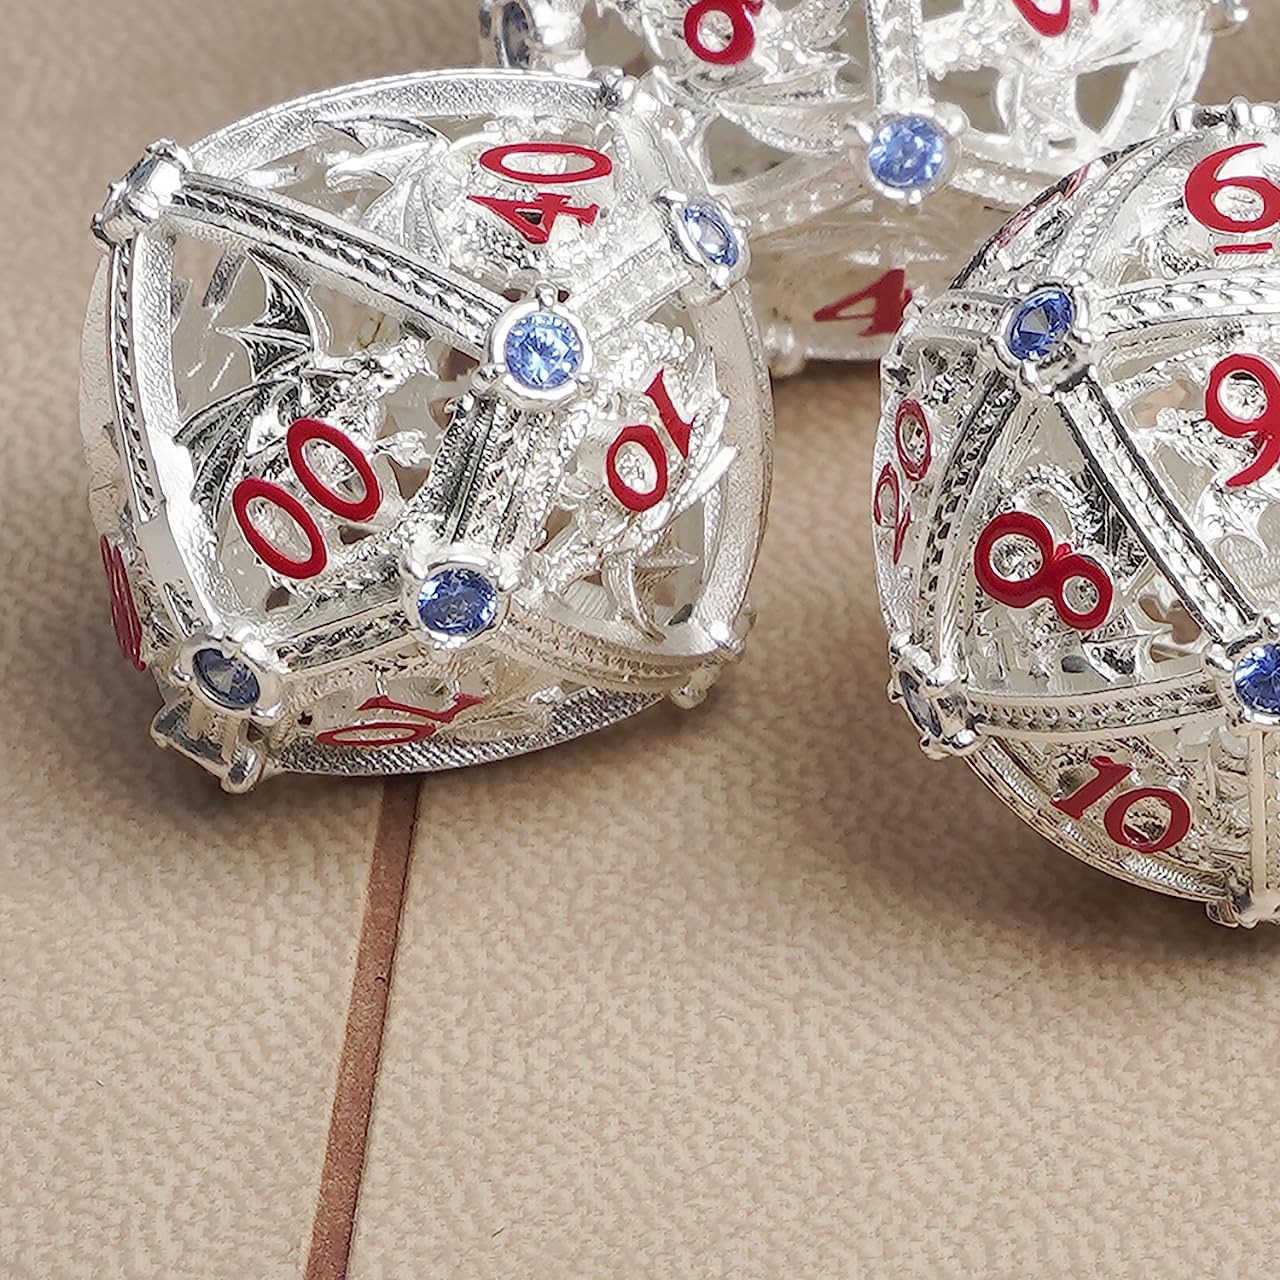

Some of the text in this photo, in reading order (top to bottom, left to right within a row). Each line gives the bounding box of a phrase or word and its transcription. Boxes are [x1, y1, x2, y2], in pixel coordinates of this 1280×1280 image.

[469, 143, 613, 244] 40
[813, 269, 912, 336] 4
[606, 369, 695, 513] 10
[233, 417, 382, 580] 00
[974, 512, 1113, 631] 8
[1052, 755, 1190, 854] 10
